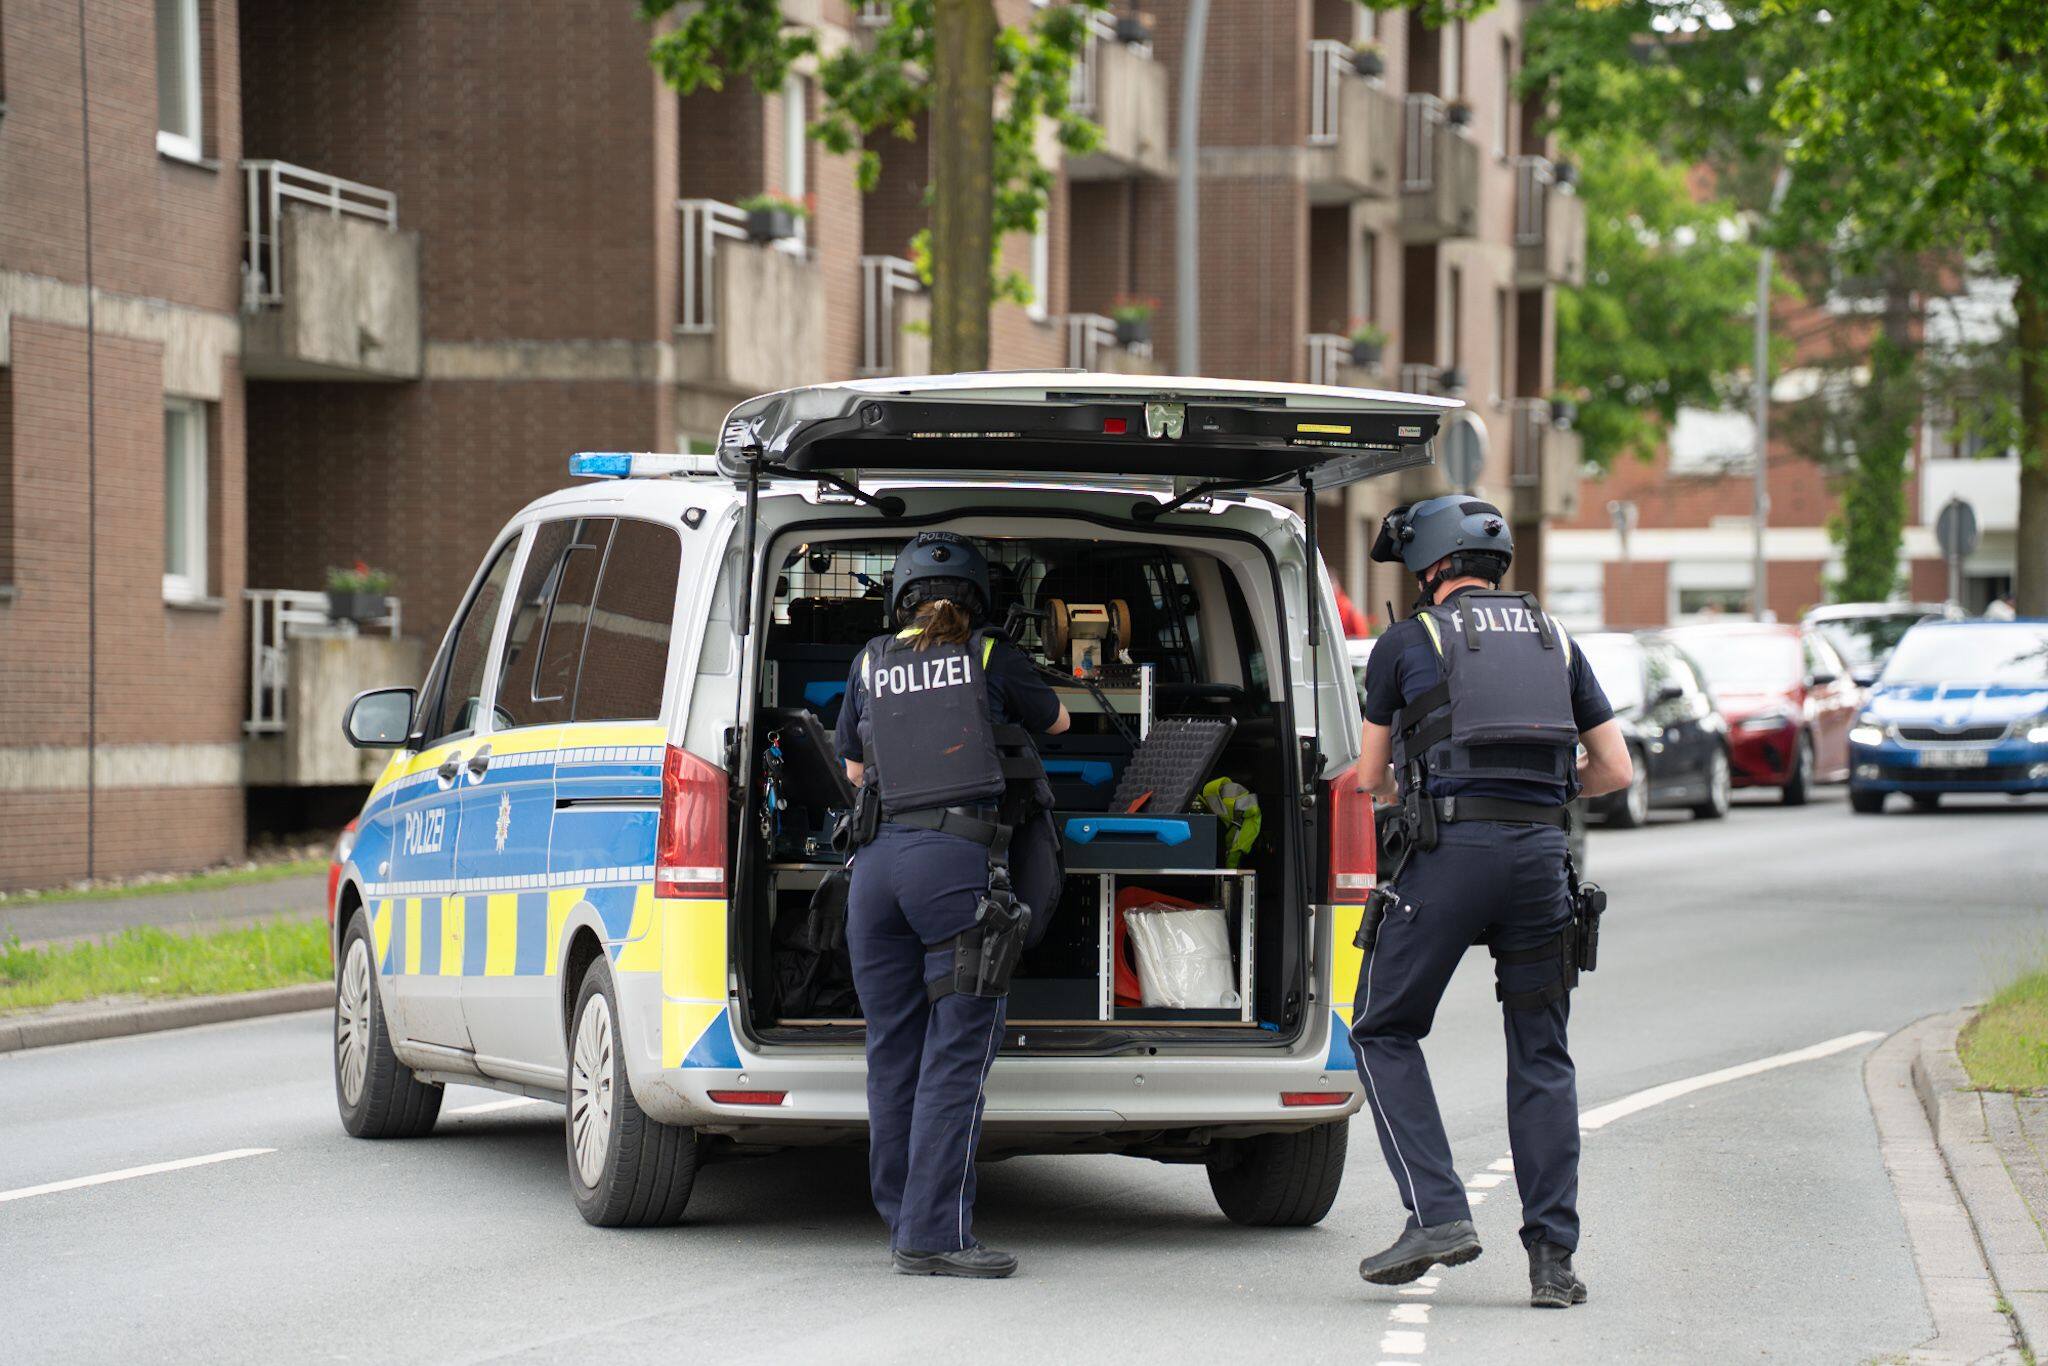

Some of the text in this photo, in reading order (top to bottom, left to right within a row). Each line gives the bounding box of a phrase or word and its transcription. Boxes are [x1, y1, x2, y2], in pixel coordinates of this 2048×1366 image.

[919, 532, 960, 543] POLIZE
[875, 655, 971, 698] POLIZEI
[403, 808, 446, 856] POLIZEI
